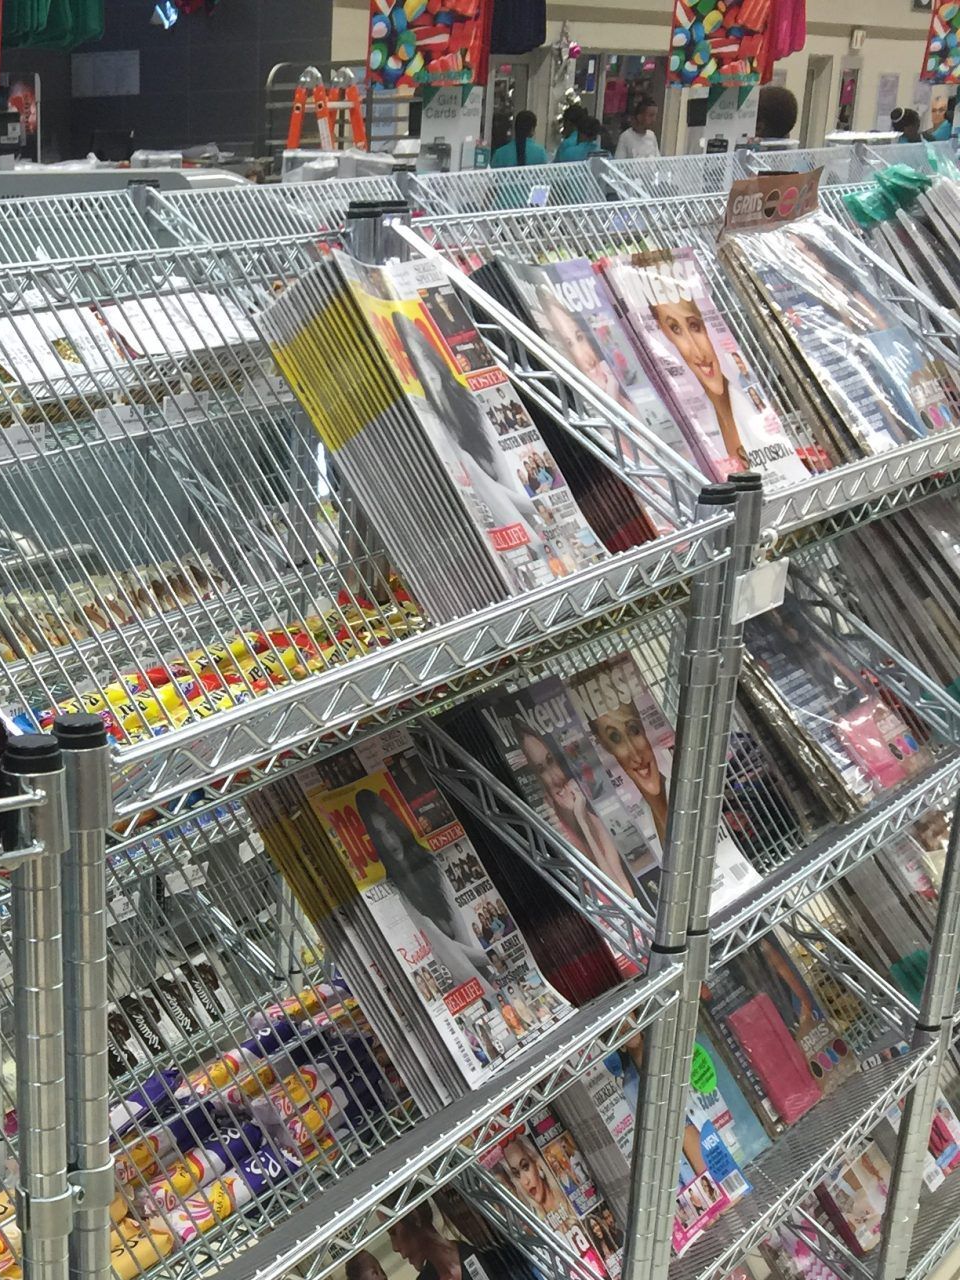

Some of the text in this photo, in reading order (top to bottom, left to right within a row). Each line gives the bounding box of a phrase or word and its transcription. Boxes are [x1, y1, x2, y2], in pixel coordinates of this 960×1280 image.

[424, 106, 457, 120] Cards
[429, 825, 465, 849] POSTER
[454, 879, 493, 909] SISTER WIVES
[444, 982, 484, 1014] REAL LIFE
[701, 1133, 721, 1152] WEN
